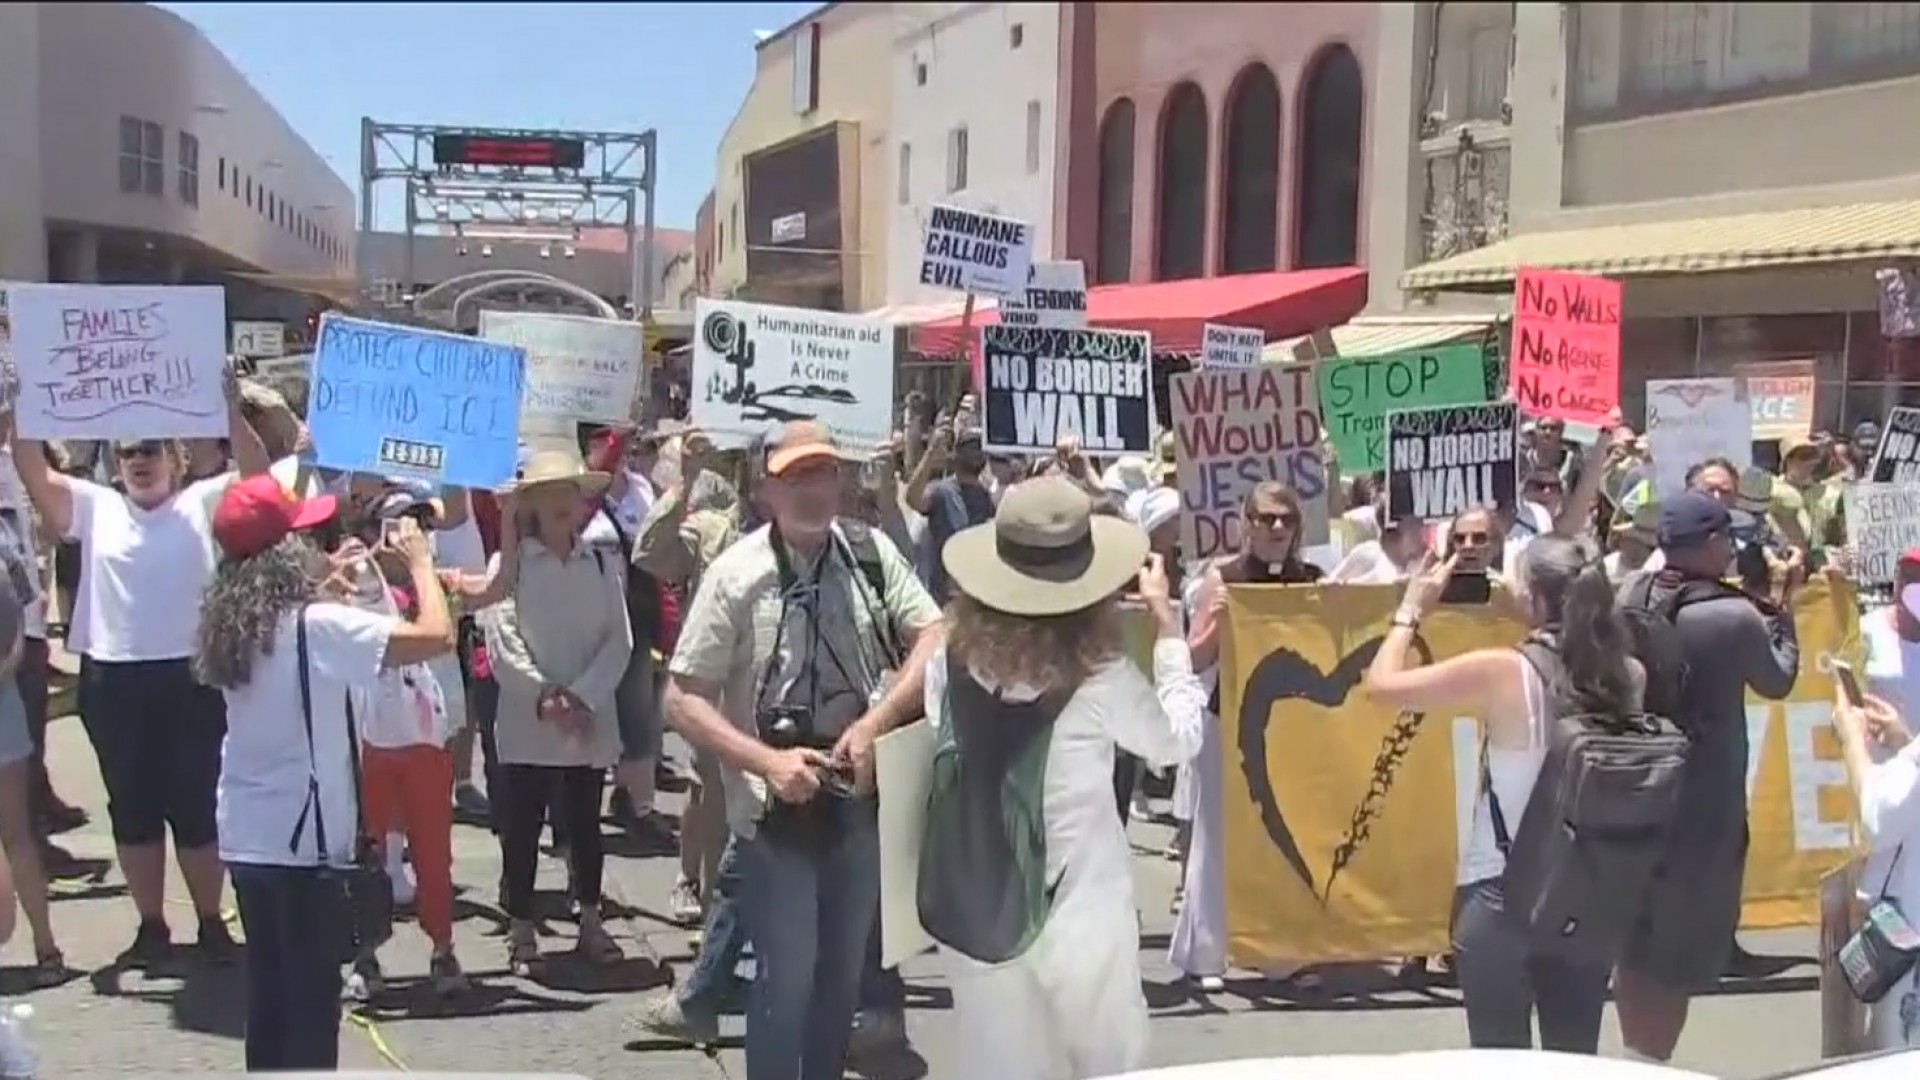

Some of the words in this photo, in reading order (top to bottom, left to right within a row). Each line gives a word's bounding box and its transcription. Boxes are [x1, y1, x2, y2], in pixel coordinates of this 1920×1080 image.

[931, 206, 1025, 245] INHUMANE
[926, 232, 1009, 269] CALLOUS
[920, 261, 964, 289] EVIL
[757, 314, 855, 340] Humanitarian
[858, 326, 881, 343] aid
[790, 339, 803, 355] Is
[807, 341, 850, 360] Never
[790, 363, 801, 379] A
[805, 363, 850, 383] Crime
[991, 353, 1029, 391] NO
[1034, 356, 1144, 397] BORDER
[1176, 367, 1311, 416] WHAT
[1330, 355, 1440, 408] STOP
[1012, 391, 1126, 450] WALL
[1178, 408, 1320, 460] WOULD
[1337, 413, 1387, 434] Tran
[1393, 436, 1425, 472] NO
[1429, 430, 1513, 468] BORDER
[1884, 431, 1916, 461] NO
[1410, 463, 1498, 518] WALL
[1857, 551, 1889, 578] NOT
